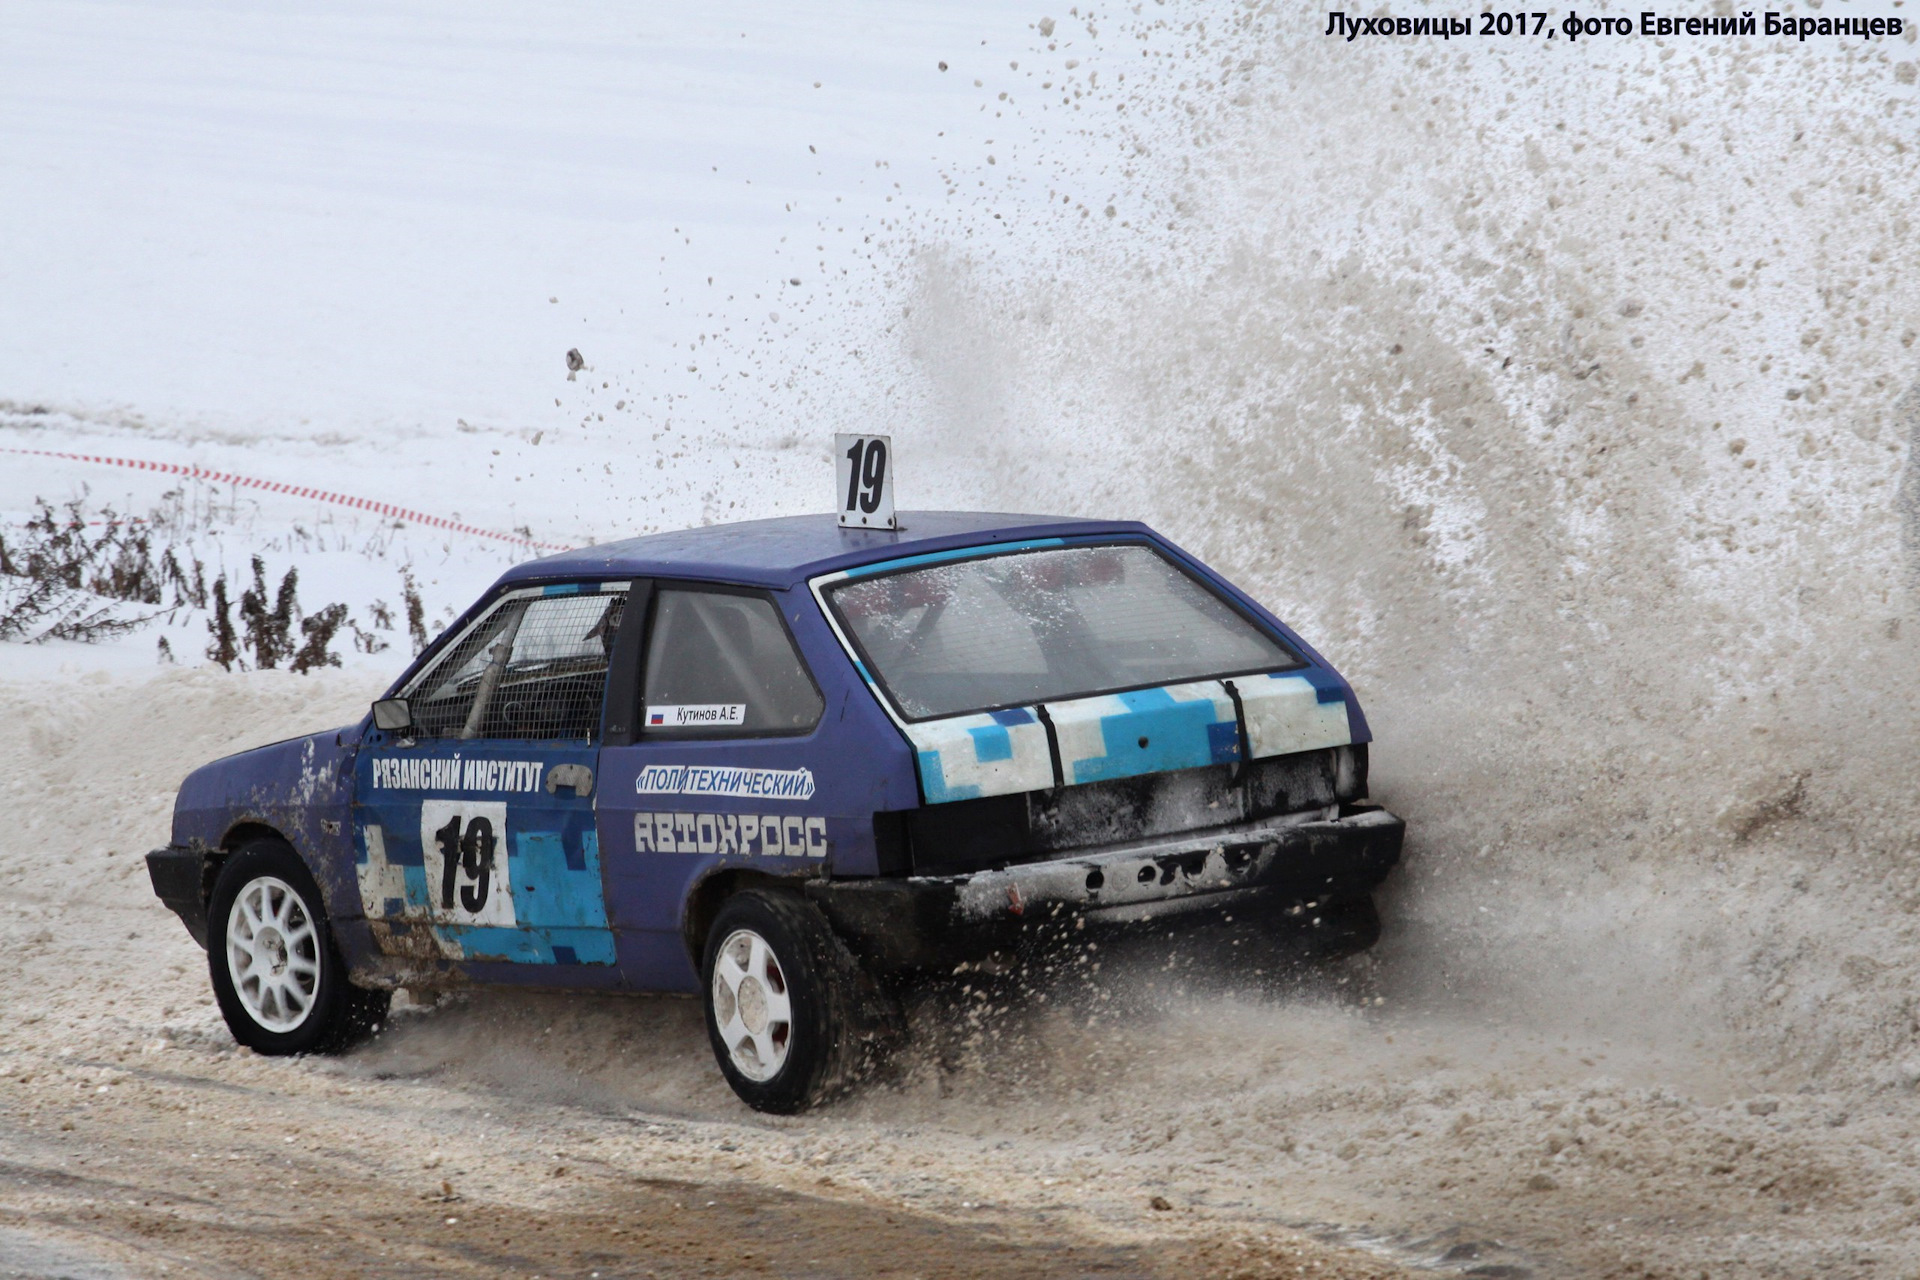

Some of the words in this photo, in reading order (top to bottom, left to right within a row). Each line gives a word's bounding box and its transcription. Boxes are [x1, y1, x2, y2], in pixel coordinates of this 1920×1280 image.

[846, 439, 887, 514] 19
[677, 707, 717, 725] Кутинов
[719, 706, 739, 720] А.Е.
[372, 753, 461, 790] РЯЗАНСКИЙ
[463, 759, 543, 793] ИНСТИТУТ
[636, 767, 814, 797] «ПОЛИТЕХНИЧЕСКИЙ»
[634, 812, 828, 858] АВТОКРОСС
[435, 815, 494, 913] 19
